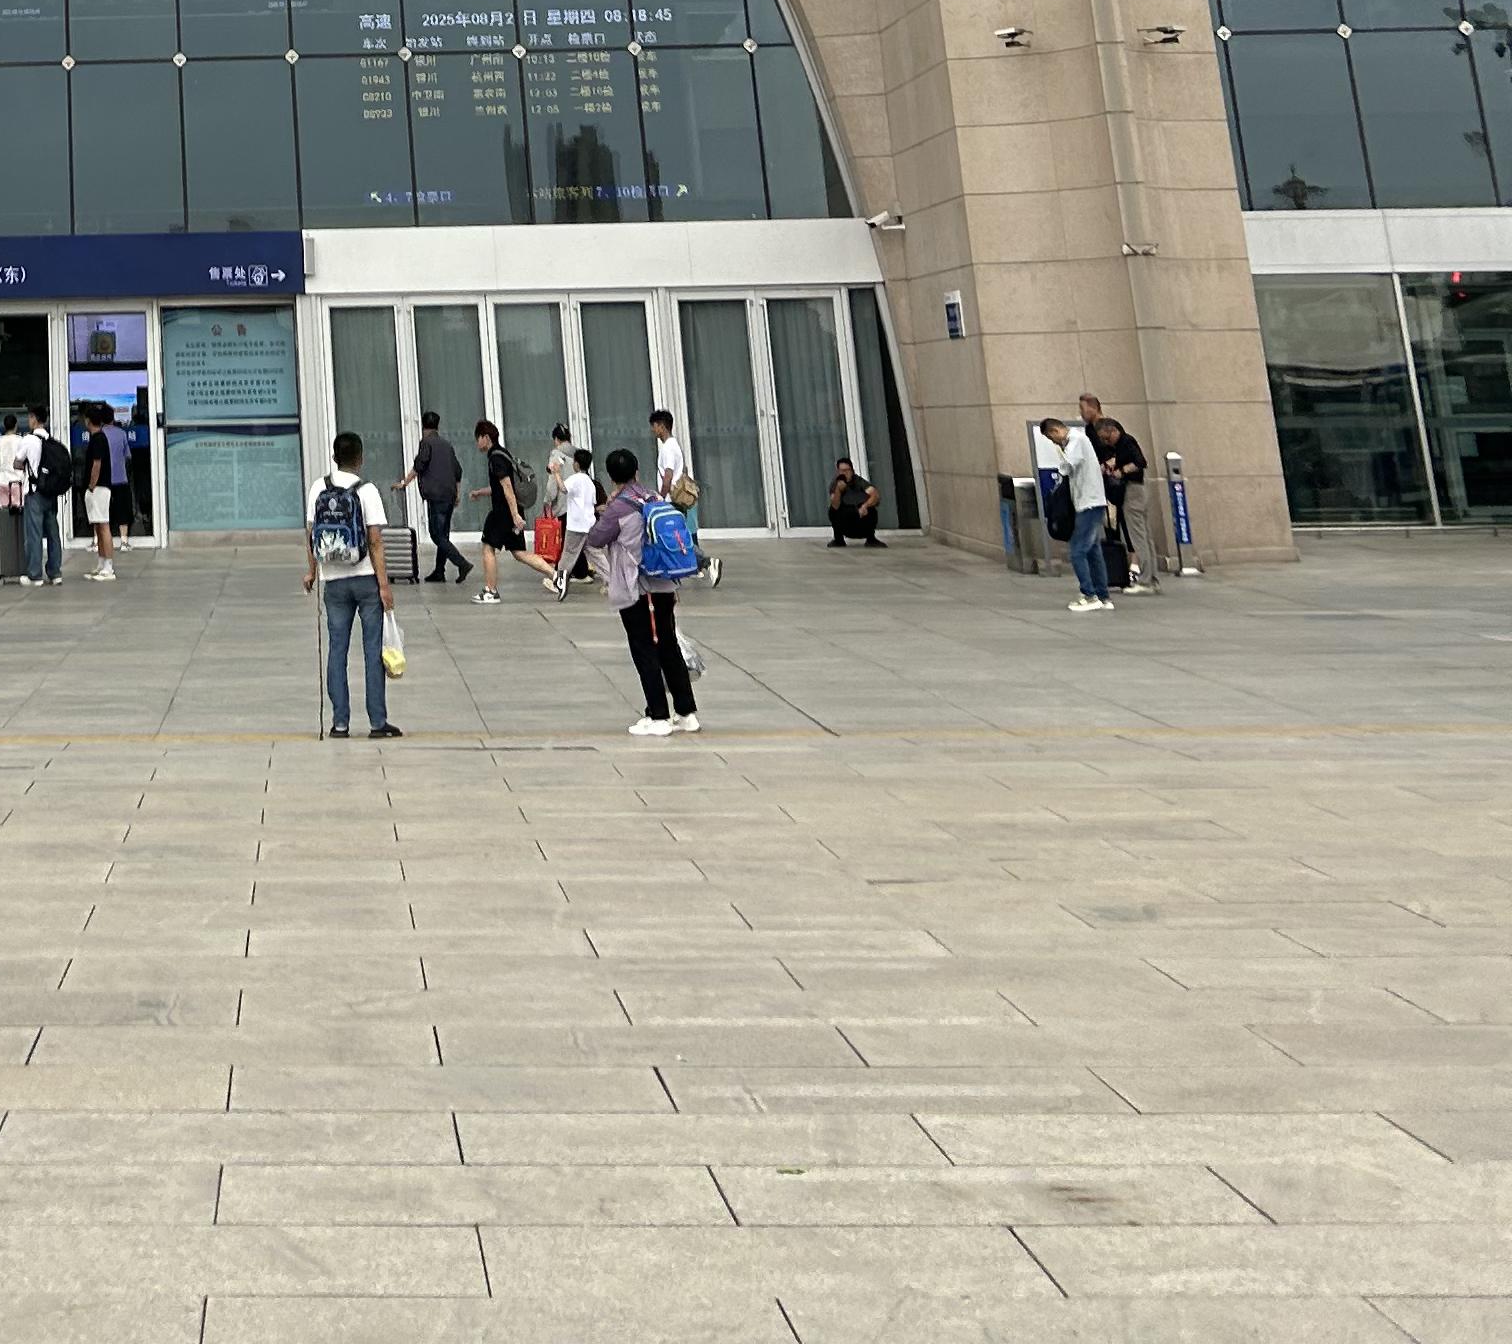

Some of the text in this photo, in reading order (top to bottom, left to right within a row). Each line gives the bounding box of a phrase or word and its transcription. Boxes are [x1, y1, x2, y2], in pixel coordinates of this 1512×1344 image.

[359, 14, 392, 30] 高速
[422, 10, 537, 28] 2025年08月2日
[547, 9, 596, 25] 星期四
[363, 37, 387, 49] 车次
[568, 32, 605, 45] 检票口
[209, 265, 246, 280] 售票处
